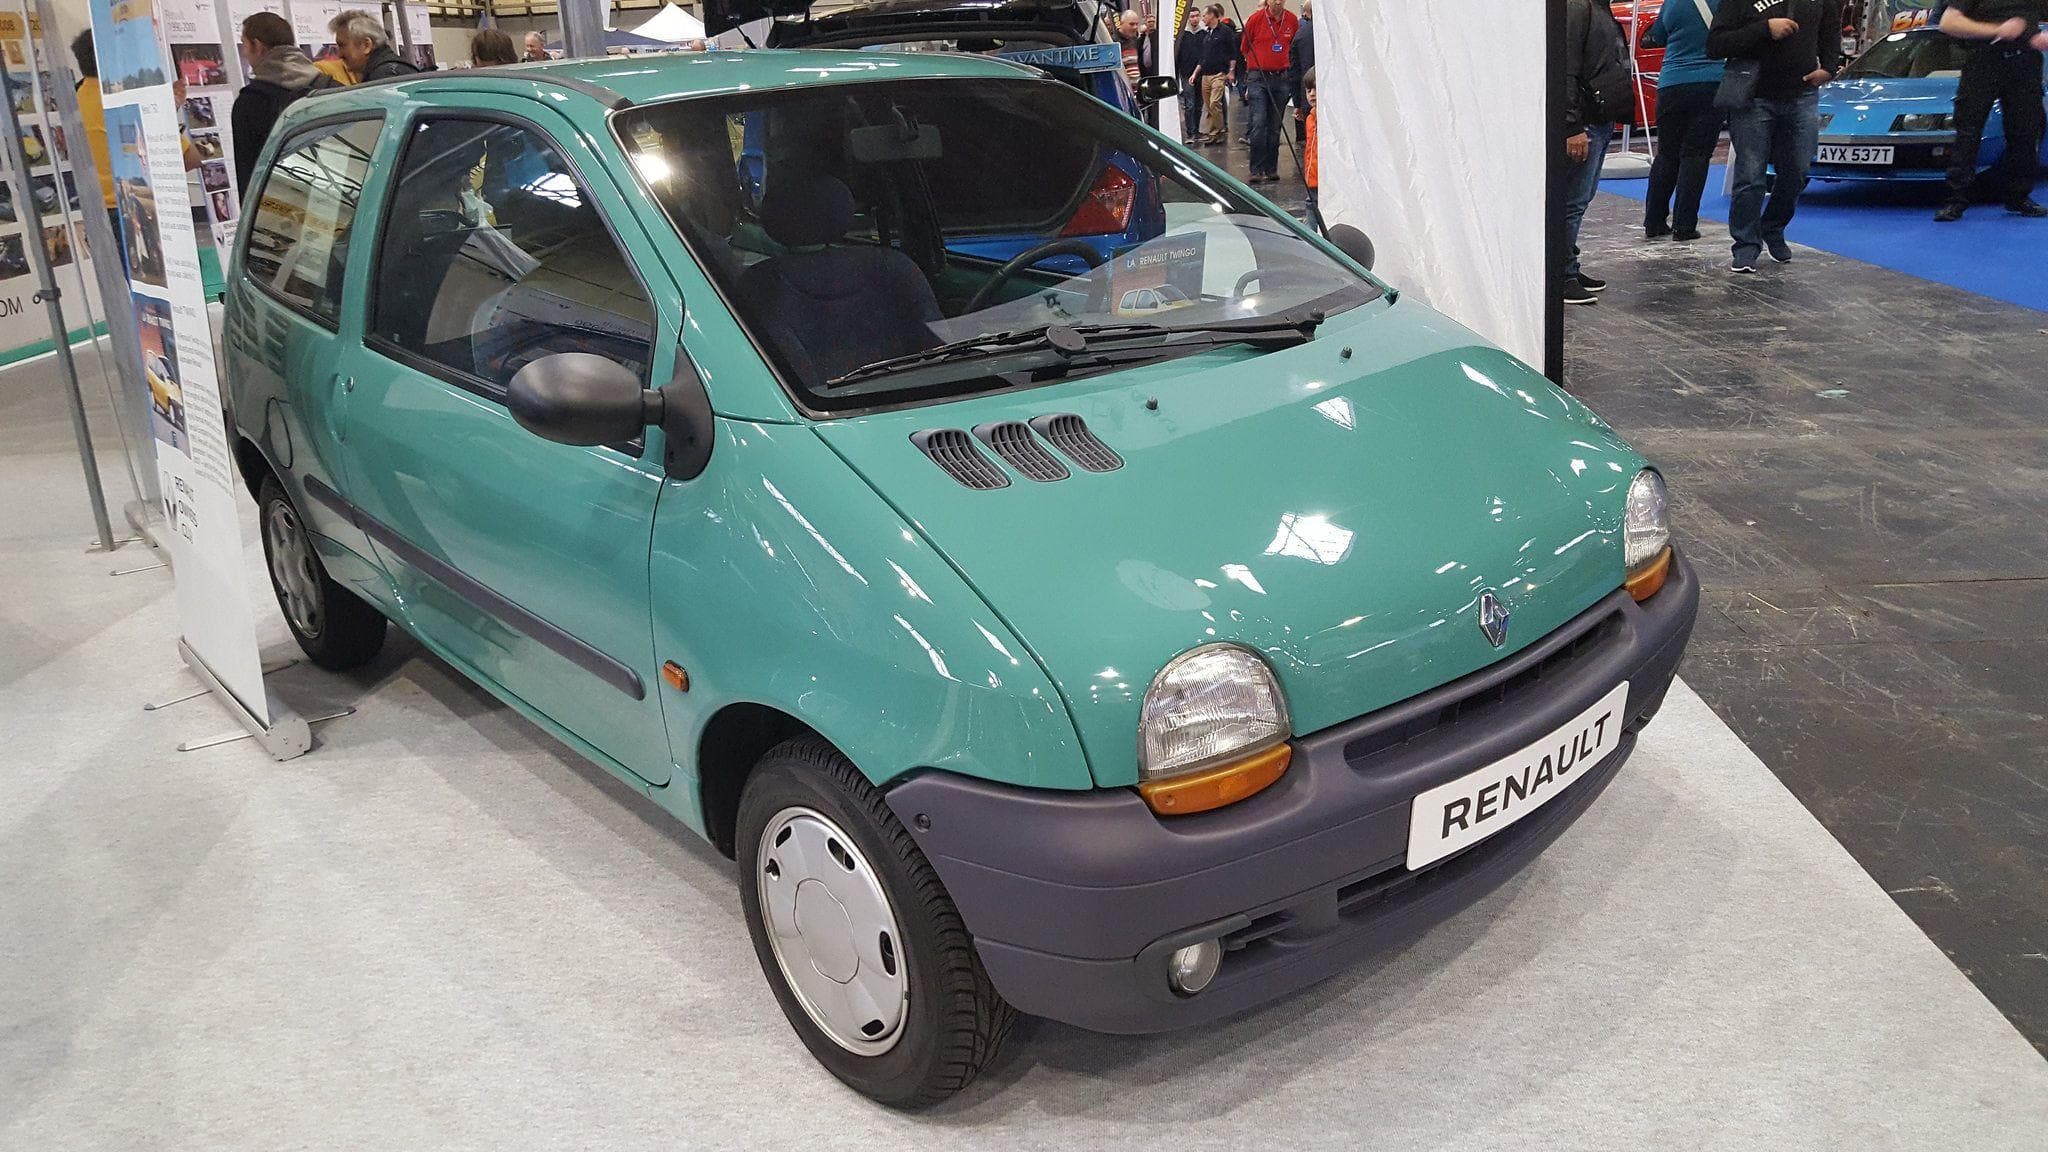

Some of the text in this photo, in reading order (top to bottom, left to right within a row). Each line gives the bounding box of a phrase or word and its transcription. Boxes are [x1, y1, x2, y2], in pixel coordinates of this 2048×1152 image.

[1891, 9, 1933, 31] BA
[1009, 47, 1099, 65] AVANTIME
[1820, 147, 1891, 162] AYX 537T
[1127, 247, 1196, 268] LA RENAULT TWINGO
[1441, 710, 1612, 840] RENAULT
